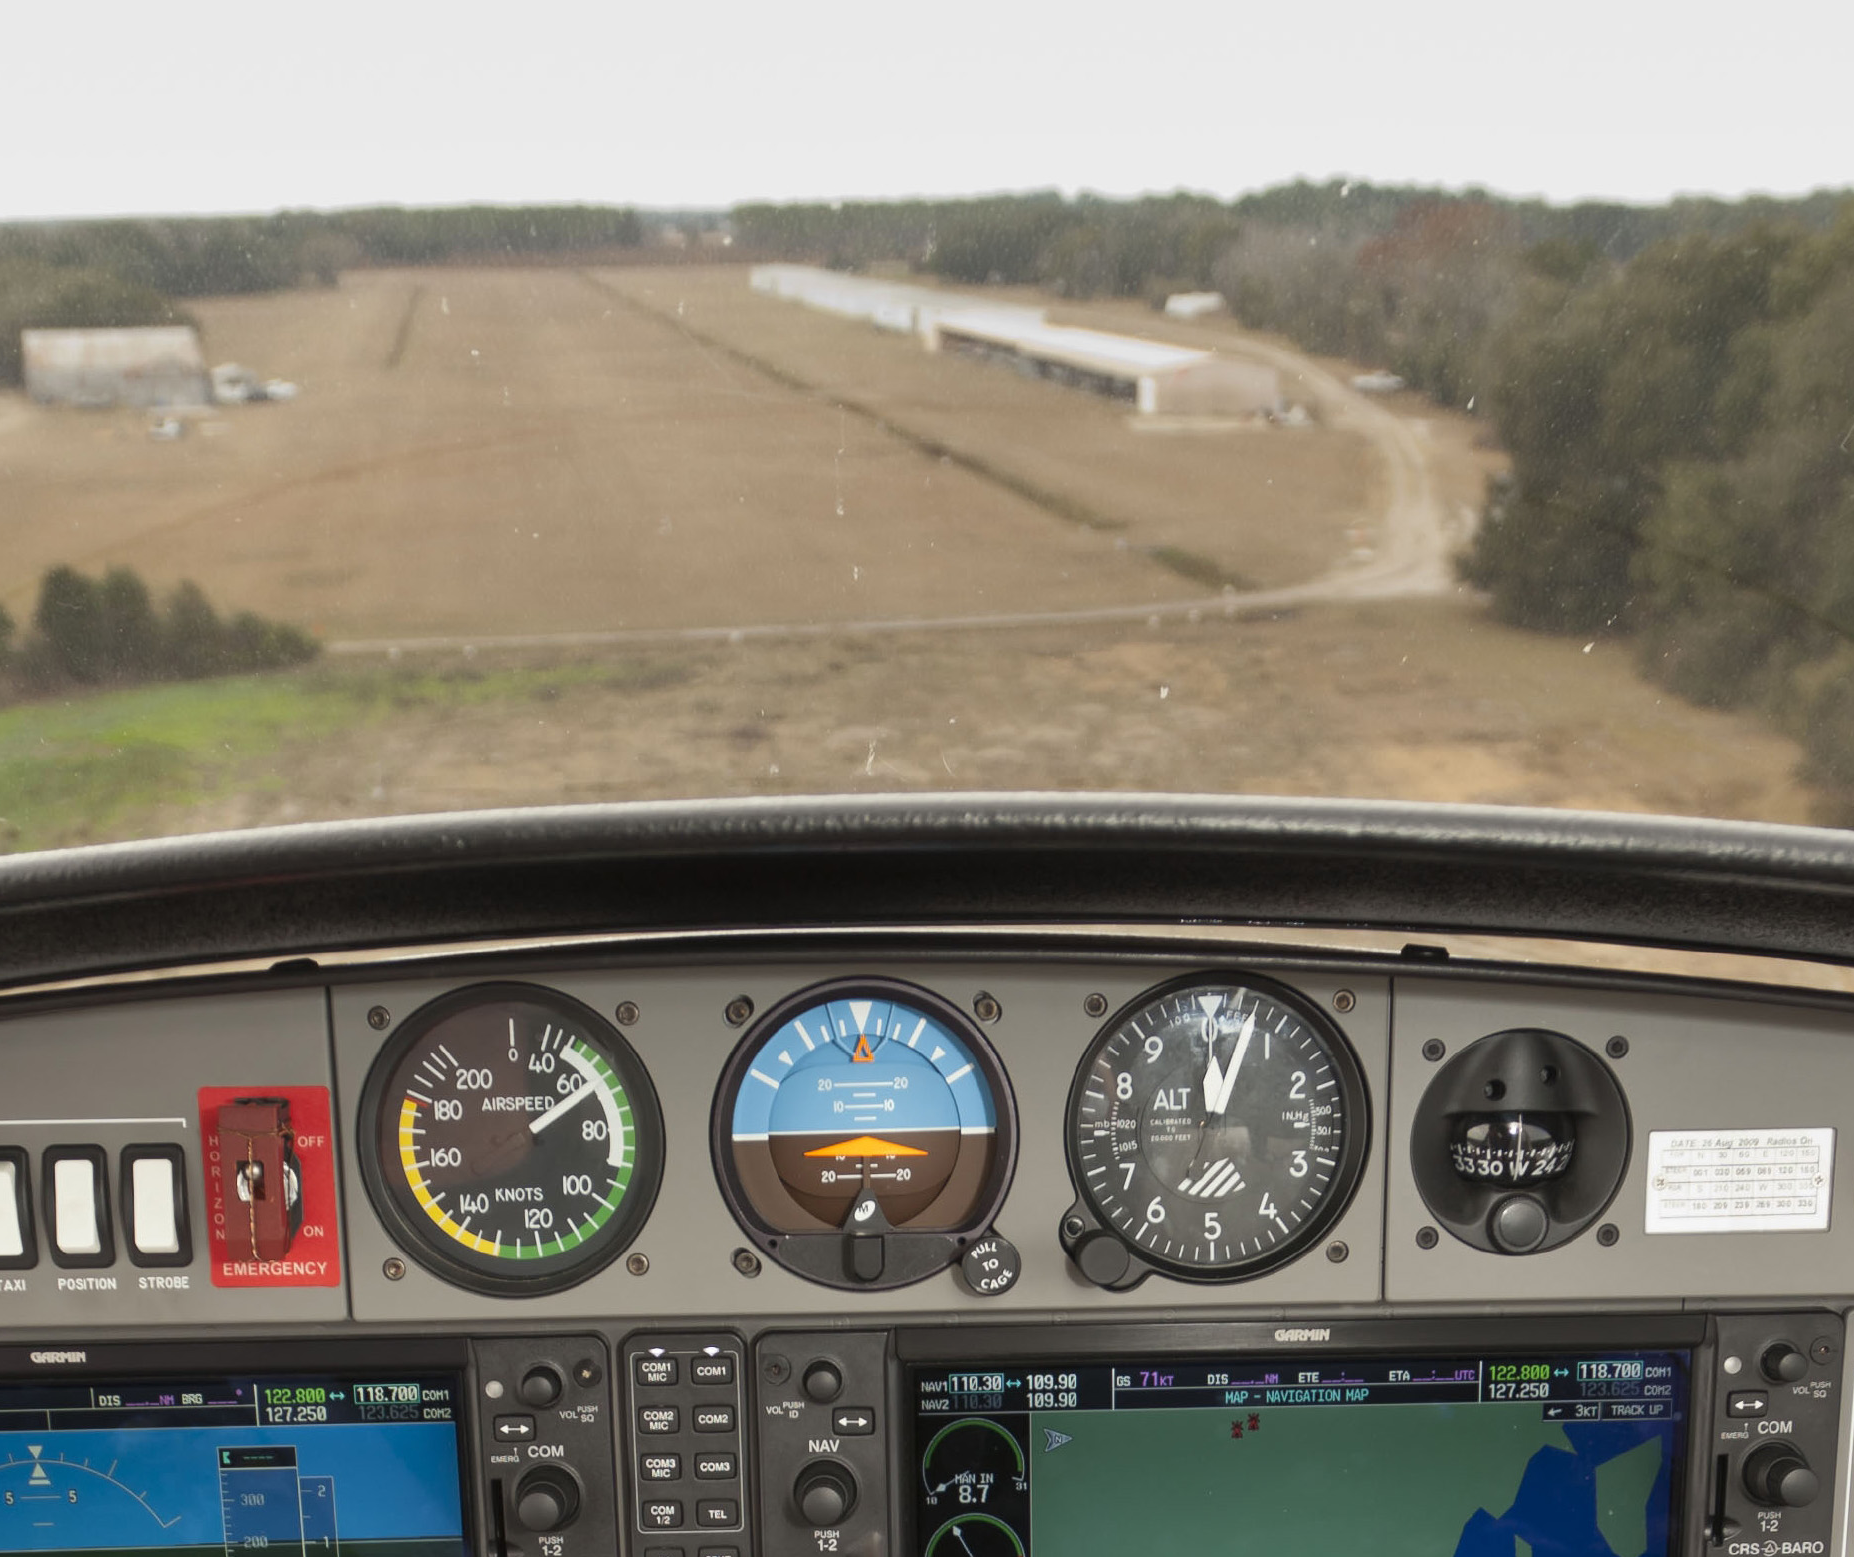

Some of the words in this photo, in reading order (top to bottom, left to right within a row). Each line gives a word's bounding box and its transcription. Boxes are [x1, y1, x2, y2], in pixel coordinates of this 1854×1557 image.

[509, 1048, 518, 1061] 0
[1144, 1036, 1163, 1063] 9
[529, 1053, 555, 1073] 40
[456, 1069, 492, 1089] 200
[556, 1073, 582, 1093] 60
[1117, 1073, 1132, 1100] 8
[1290, 1071, 1305, 1099] 2
[482, 1097, 554, 1111] AIRSPEED
[1154, 1088, 1190, 1110] ALT
[434, 1100, 462, 1120] 180
[582, 1120, 606, 1140] 80
[298, 1136, 323, 1147] OFF
[1714, 1137, 1733, 1149] Aug
[1738, 1138, 1759, 1146] 2009
[1767, 1137, 1797, 1146] Radios
[431, 1148, 461, 1167] 160
[1290, 1151, 1307, 1177] 3
[1119, 1163, 1135, 1190] 7
[1477, 1160, 1503, 1176] 30
[212, 1136, 222, 1241] HORIZON
[495, 1187, 543, 1201] KNOTS
[563, 1175, 592, 1195] 100
[460, 1193, 489, 1213] 140
[1147, 1196, 1165, 1223] 6
[1259, 1193, 1277, 1219] 4
[525, 1208, 553, 1228] 120
[1204, 1213, 1221, 1240] 5
[304, 1226, 323, 1236] ON
[971, 1242, 996, 1258] PULL
[224, 1261, 326, 1275] EMERGENCY
[982, 1259, 998, 1271] TO
[58, 1278, 116, 1290] POSITION
[139, 1276, 189, 1289] STROBE
[981, 1270, 1012, 1289] CAGE
[31, 1352, 86, 1363] GARMIN
[265, 1388, 325, 1404] 122.800
[356, 1385, 417, 1402] 118.700
[266, 1406, 326, 1422] 127.250
[528, 1445, 563, 1457] COM
[809, 1440, 839, 1452] NAV
